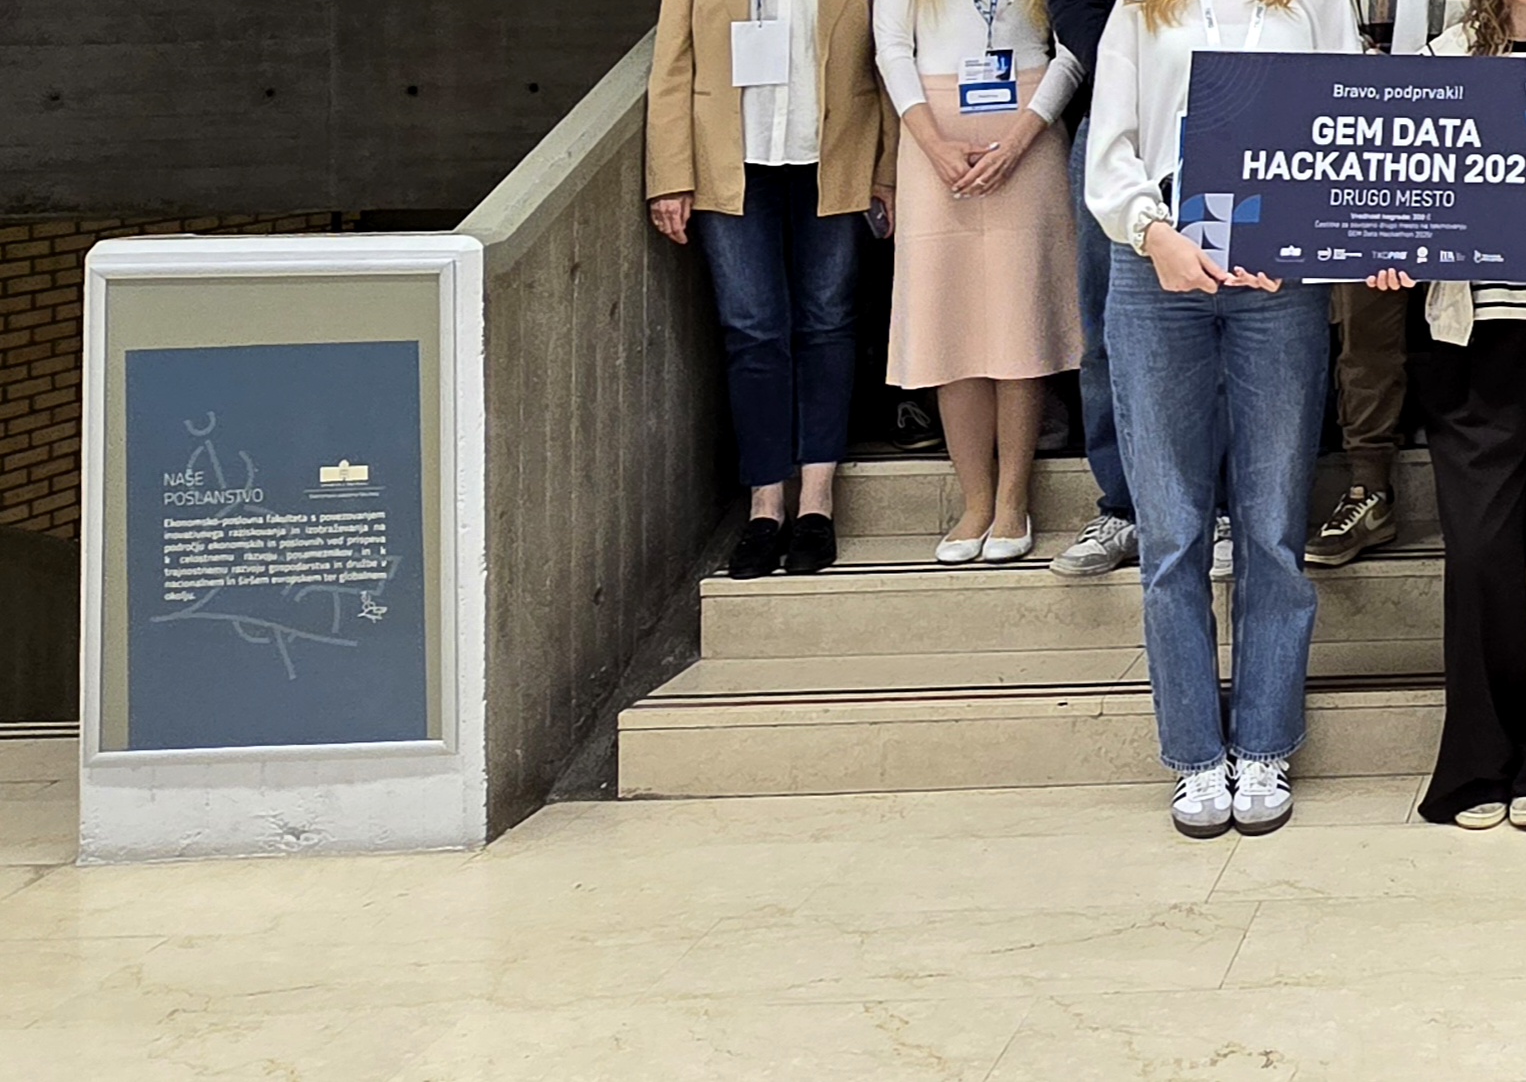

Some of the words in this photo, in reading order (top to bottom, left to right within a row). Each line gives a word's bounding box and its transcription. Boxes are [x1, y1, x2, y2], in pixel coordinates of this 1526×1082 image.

[1333, 84, 1380, 101] Bravo,
[1384, 85, 1464, 102] podprvaki!
[1311, 116, 1386, 147] GEM
[1391, 117, 1482, 148] DATA
[1242, 150, 1457, 183] HACKATHON
[1330, 188, 1391, 207] DRUGO
[1395, 189, 1456, 208] MESTO
[163, 488, 263, 506] POSLANSTVO
